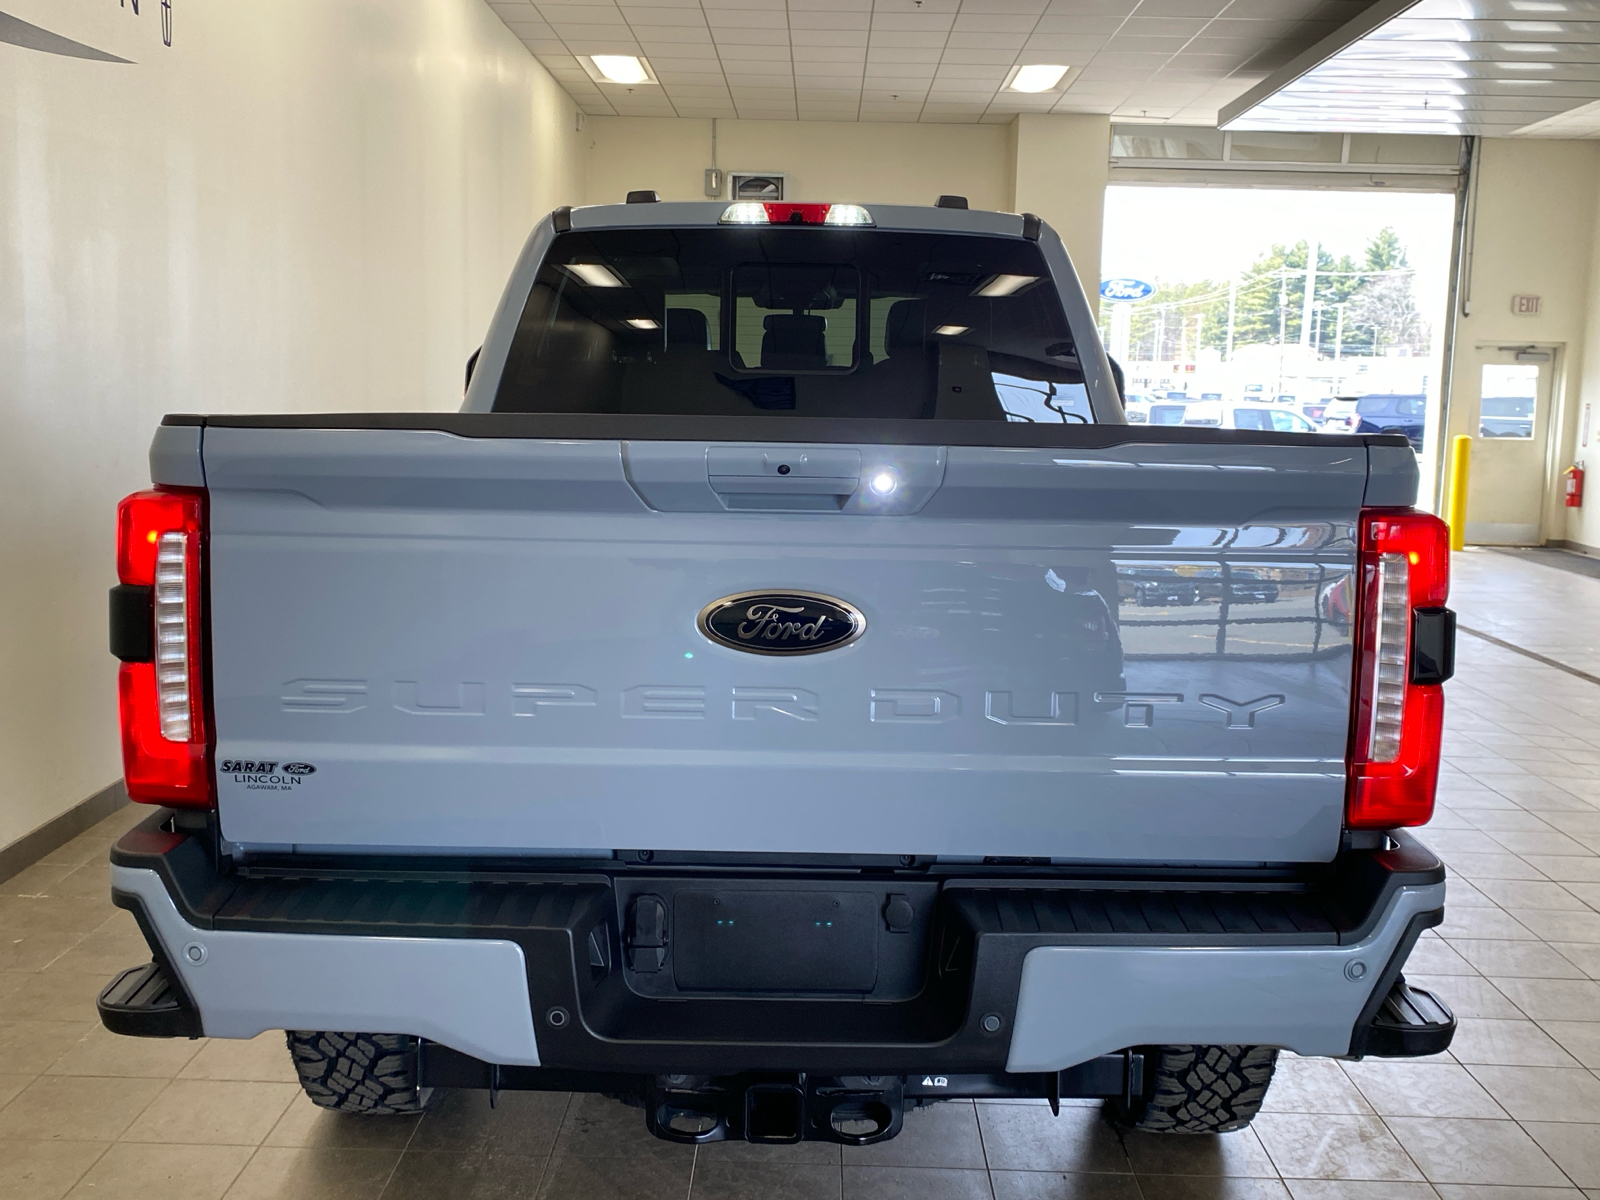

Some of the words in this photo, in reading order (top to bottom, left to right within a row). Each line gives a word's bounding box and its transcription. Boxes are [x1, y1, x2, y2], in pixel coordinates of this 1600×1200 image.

[1104, 279, 1145, 298] Ford
[1519, 296, 1540, 313] EXIT
[737, 603, 827, 641] Ford
[279, 678, 819, 723] SUPER
[869, 688, 1287, 730] DUTY
[220, 760, 279, 774] SARAT
[287, 764, 311, 775] Ford
[234, 774, 301, 785] LINCOLN
[246, 784, 280, 792] AGAWAM,
